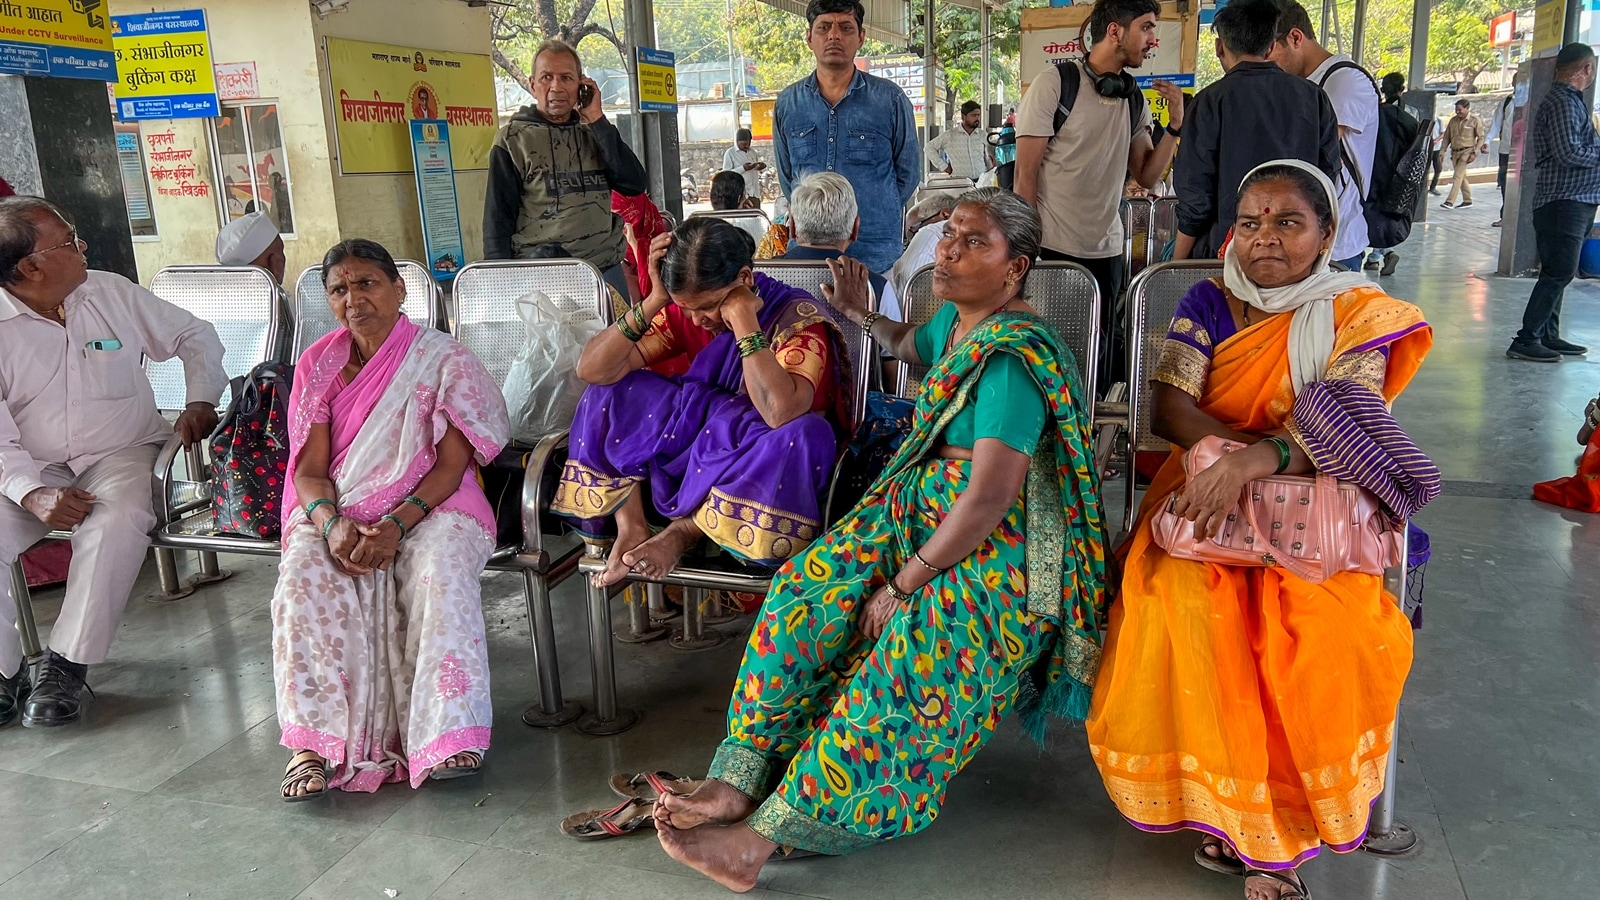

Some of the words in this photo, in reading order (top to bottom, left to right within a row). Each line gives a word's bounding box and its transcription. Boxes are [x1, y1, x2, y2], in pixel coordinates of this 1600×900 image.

[26, 6, 63, 24] आहात
[126, 21, 164, 32] शिवाजीनगर
[165, 19, 200, 30] बसस्थानक
[0, 25, 25, 36] Under
[28, 28, 51, 39] CCTV
[54, 33, 104, 45] Surveillance
[130, 40, 204, 61] संभाजीनगर
[53, 56, 64, 64] एक
[65, 55, 84, 66] परिवार
[125, 66, 167, 91] बुकिंग
[168, 69, 198, 86] कक्ष
[340, 89, 406, 123] शिवाजीनगर
[445, 106, 493, 127] बसस्थानक
[147, 129, 175, 147] छत्रपती
[149, 147, 193, 163] संभाजीनगर
[181, 181, 209, 198] खिडकी
